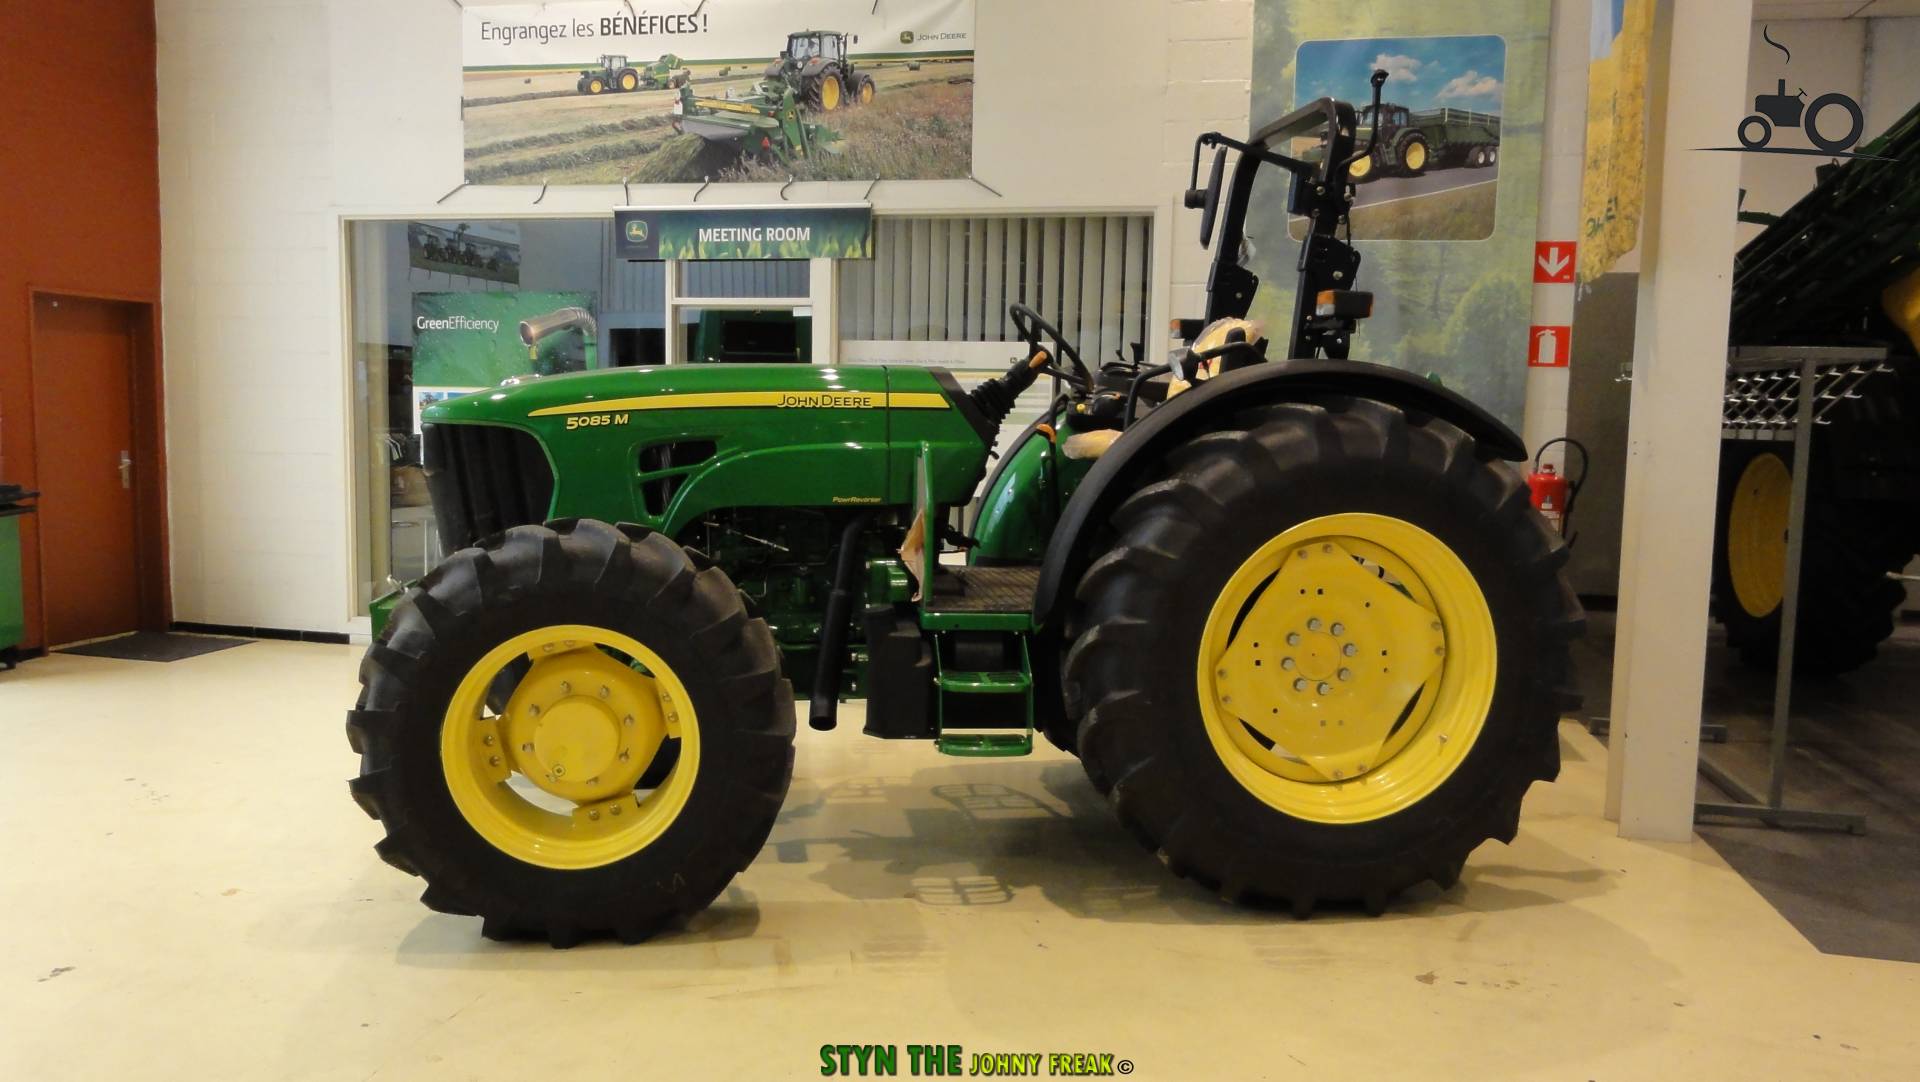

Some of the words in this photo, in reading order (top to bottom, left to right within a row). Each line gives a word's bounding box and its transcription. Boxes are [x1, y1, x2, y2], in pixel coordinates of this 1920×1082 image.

[481, 21, 567, 46] Engrangez
[572, 18, 594, 38] les
[600, 10, 698, 37] BÉNÉFICES
[916, 32, 939, 41] JOHN
[940, 32, 967, 40] DEERE
[699, 228, 762, 242] MEETING
[766, 227, 811, 242] ROOM
[416, 316, 500, 334] GreenEfficiency
[777, 394, 818, 407] JOHN
[821, 394, 872, 407] DEERE
[566, 414, 611, 430] 5085
[614, 413, 629, 425] M
